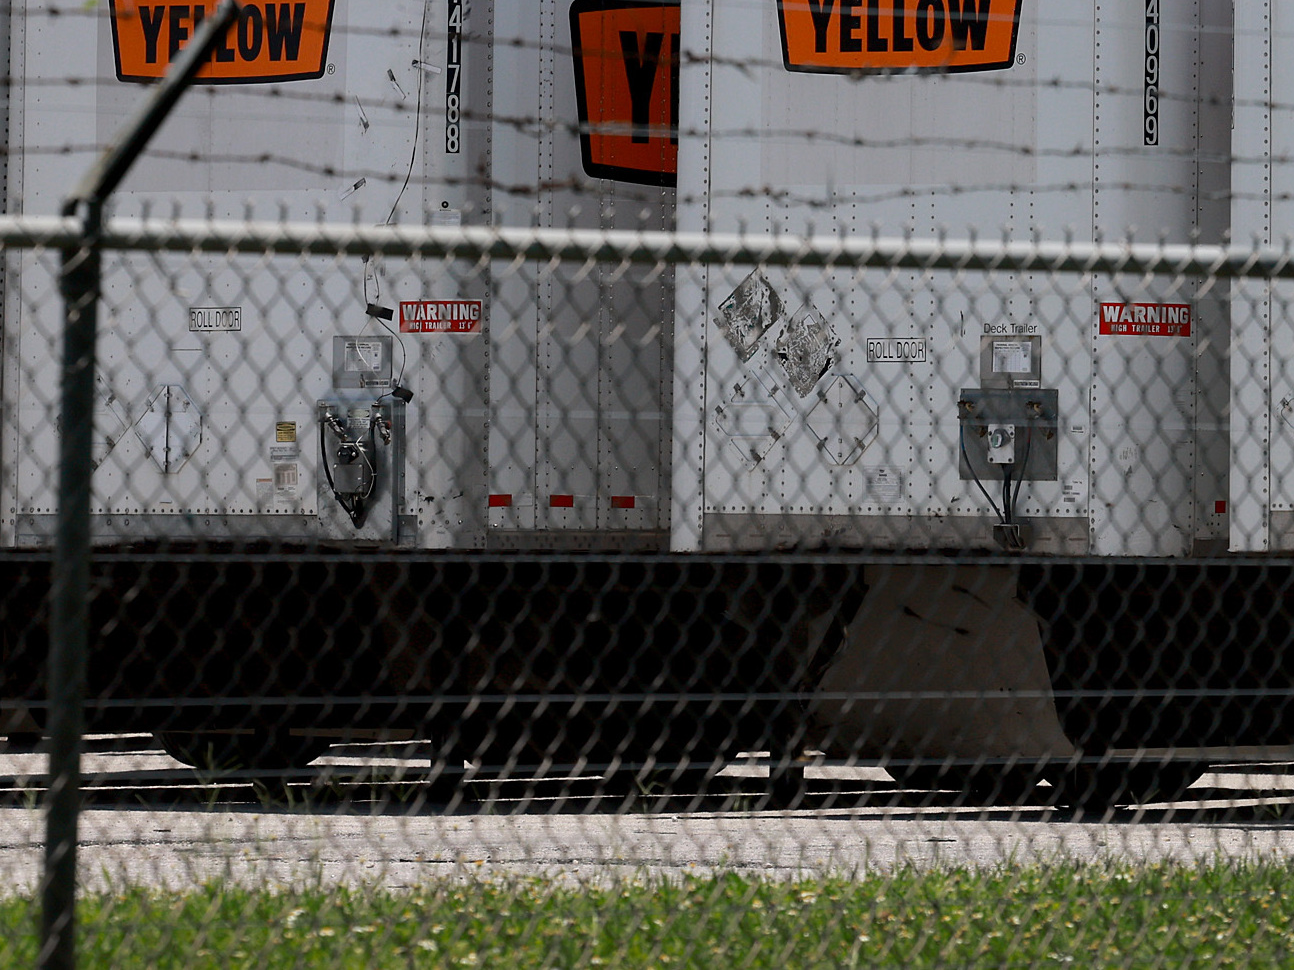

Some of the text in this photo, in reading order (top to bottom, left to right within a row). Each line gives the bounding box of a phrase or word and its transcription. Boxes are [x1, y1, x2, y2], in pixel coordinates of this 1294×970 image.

[191, 311, 240, 327] ROLL DOOR
[402, 304, 479, 320] WARNING
[1103, 306, 1189, 324] WARNING
[984, 323, 1038, 334] Deck Trailer
[869, 342, 924, 358] ROLL DOOR
